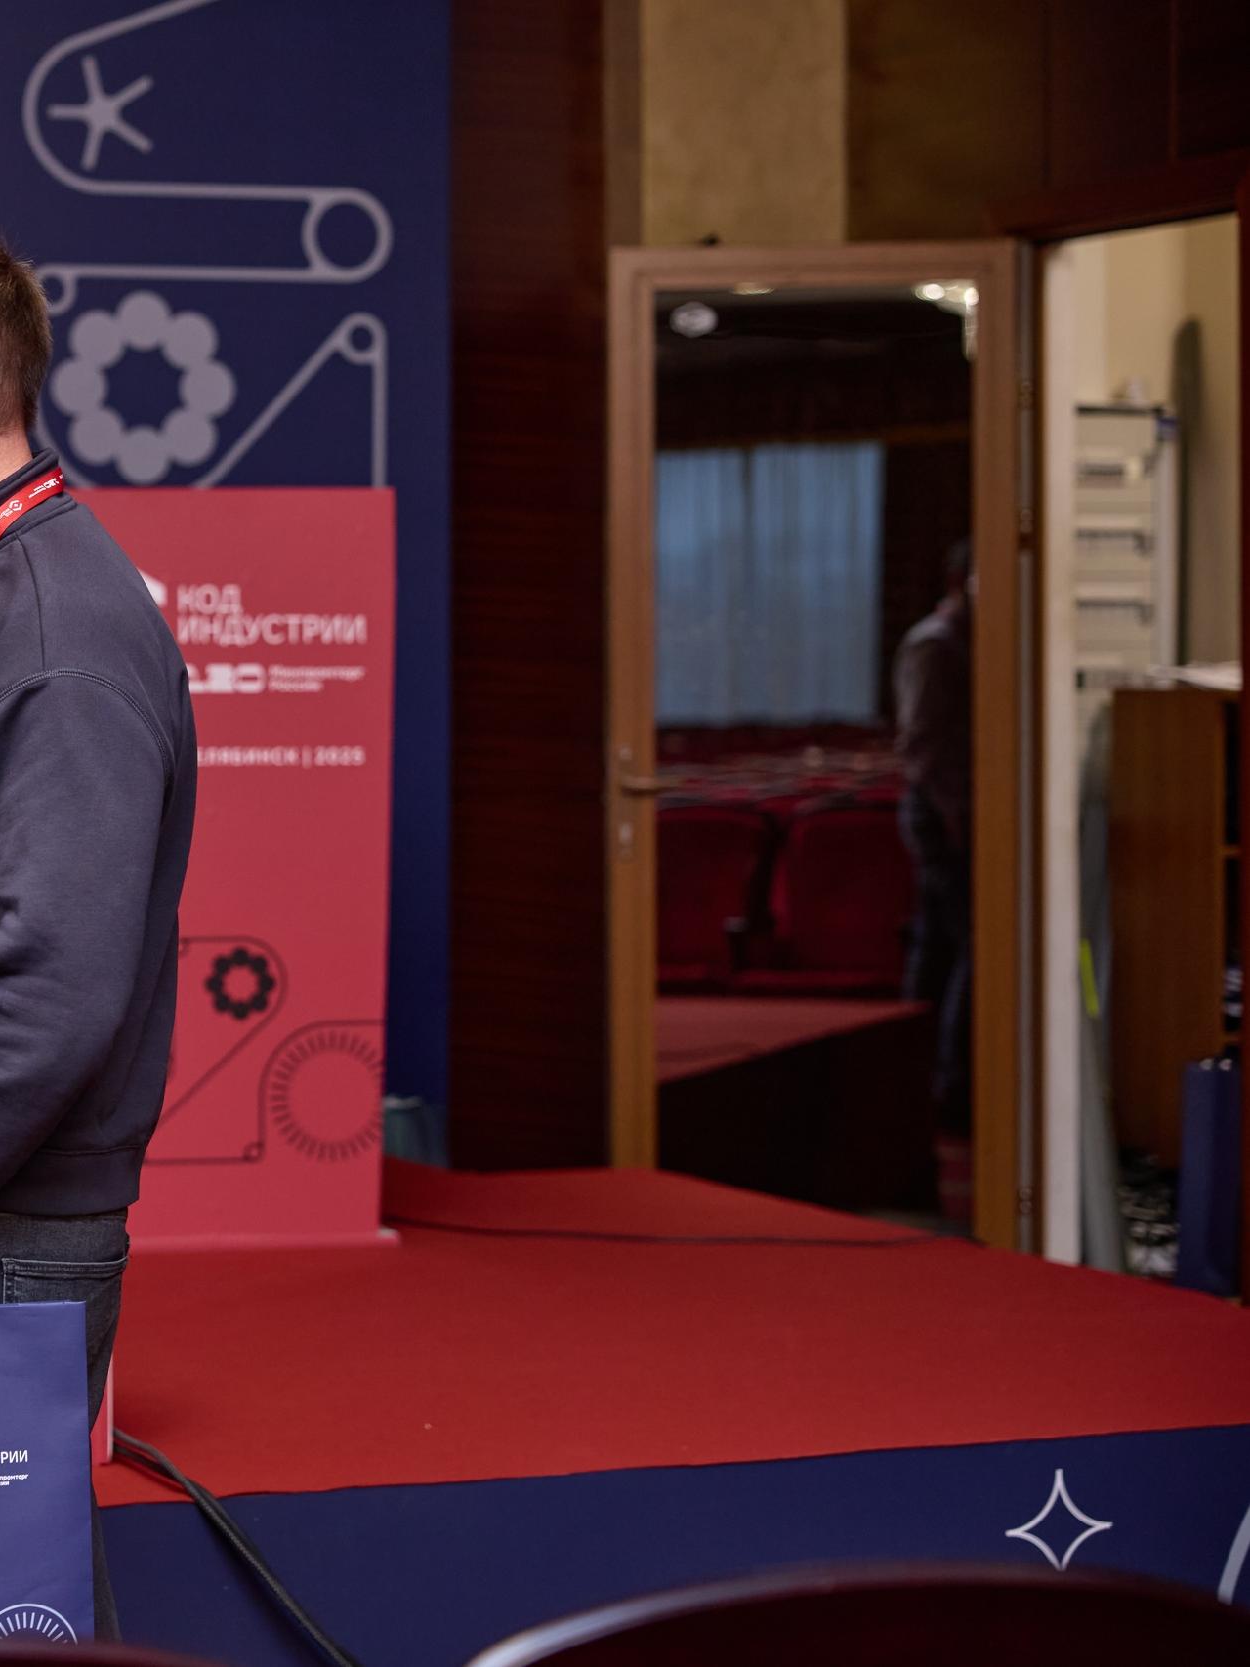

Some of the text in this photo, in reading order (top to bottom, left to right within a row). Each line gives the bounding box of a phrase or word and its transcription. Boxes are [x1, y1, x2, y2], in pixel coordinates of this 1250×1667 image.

[176, 583, 244, 616] КОД
[176, 613, 368, 648] ИНДУСТРИИ
[314, 744, 367, 767] 2025
